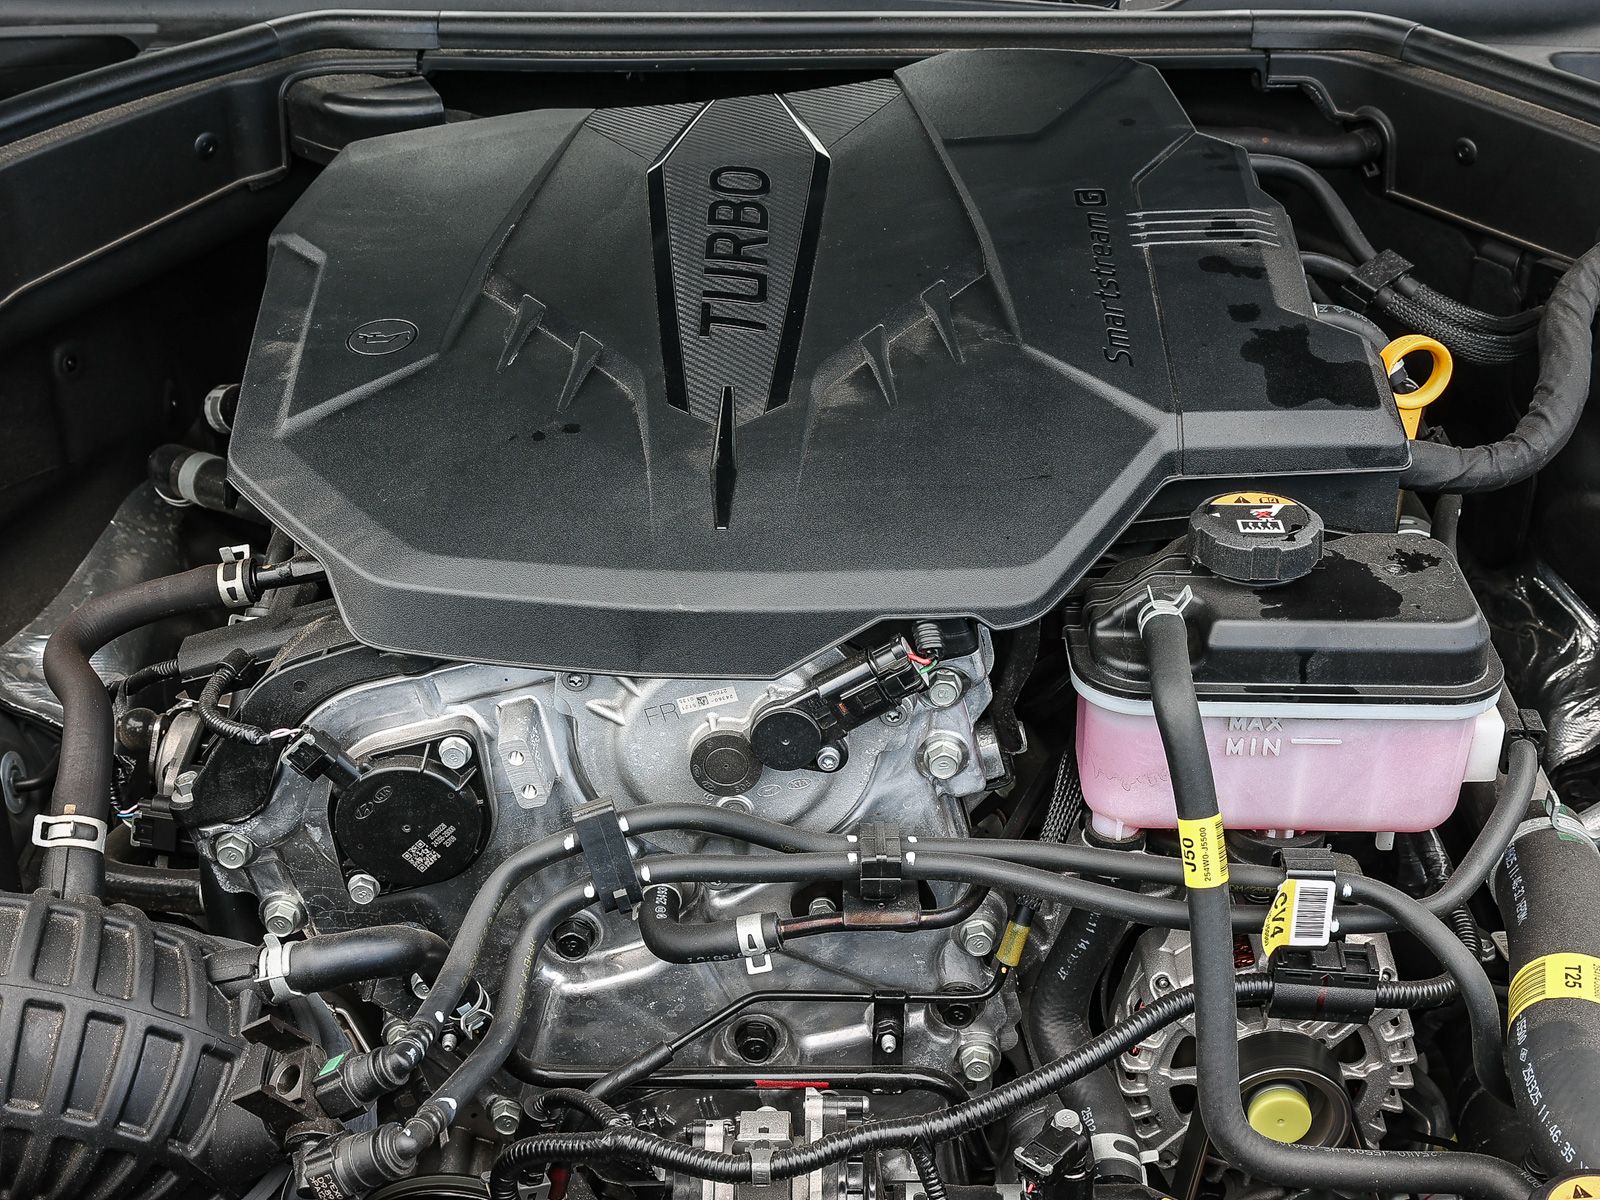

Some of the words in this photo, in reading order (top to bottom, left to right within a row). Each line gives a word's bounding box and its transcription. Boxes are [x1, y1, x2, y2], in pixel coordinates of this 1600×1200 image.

[699, 165, 771, 339] TURBO
[1087, 211, 1134, 368] Smartstream
[644, 702, 680, 726] FR
[1228, 717, 1283, 732] MAX
[1226, 738, 1281, 757] MIN
[1182, 837, 1197, 873] J50
[1200, 827, 1212, 882] 254W0-J5500
[1270, 892, 1288, 938] CV4
[1564, 965, 1582, 989] T25
[1522, 1063, 1543, 1106] 250325
[1538, 1104, 1576, 1163] 11:46:35
